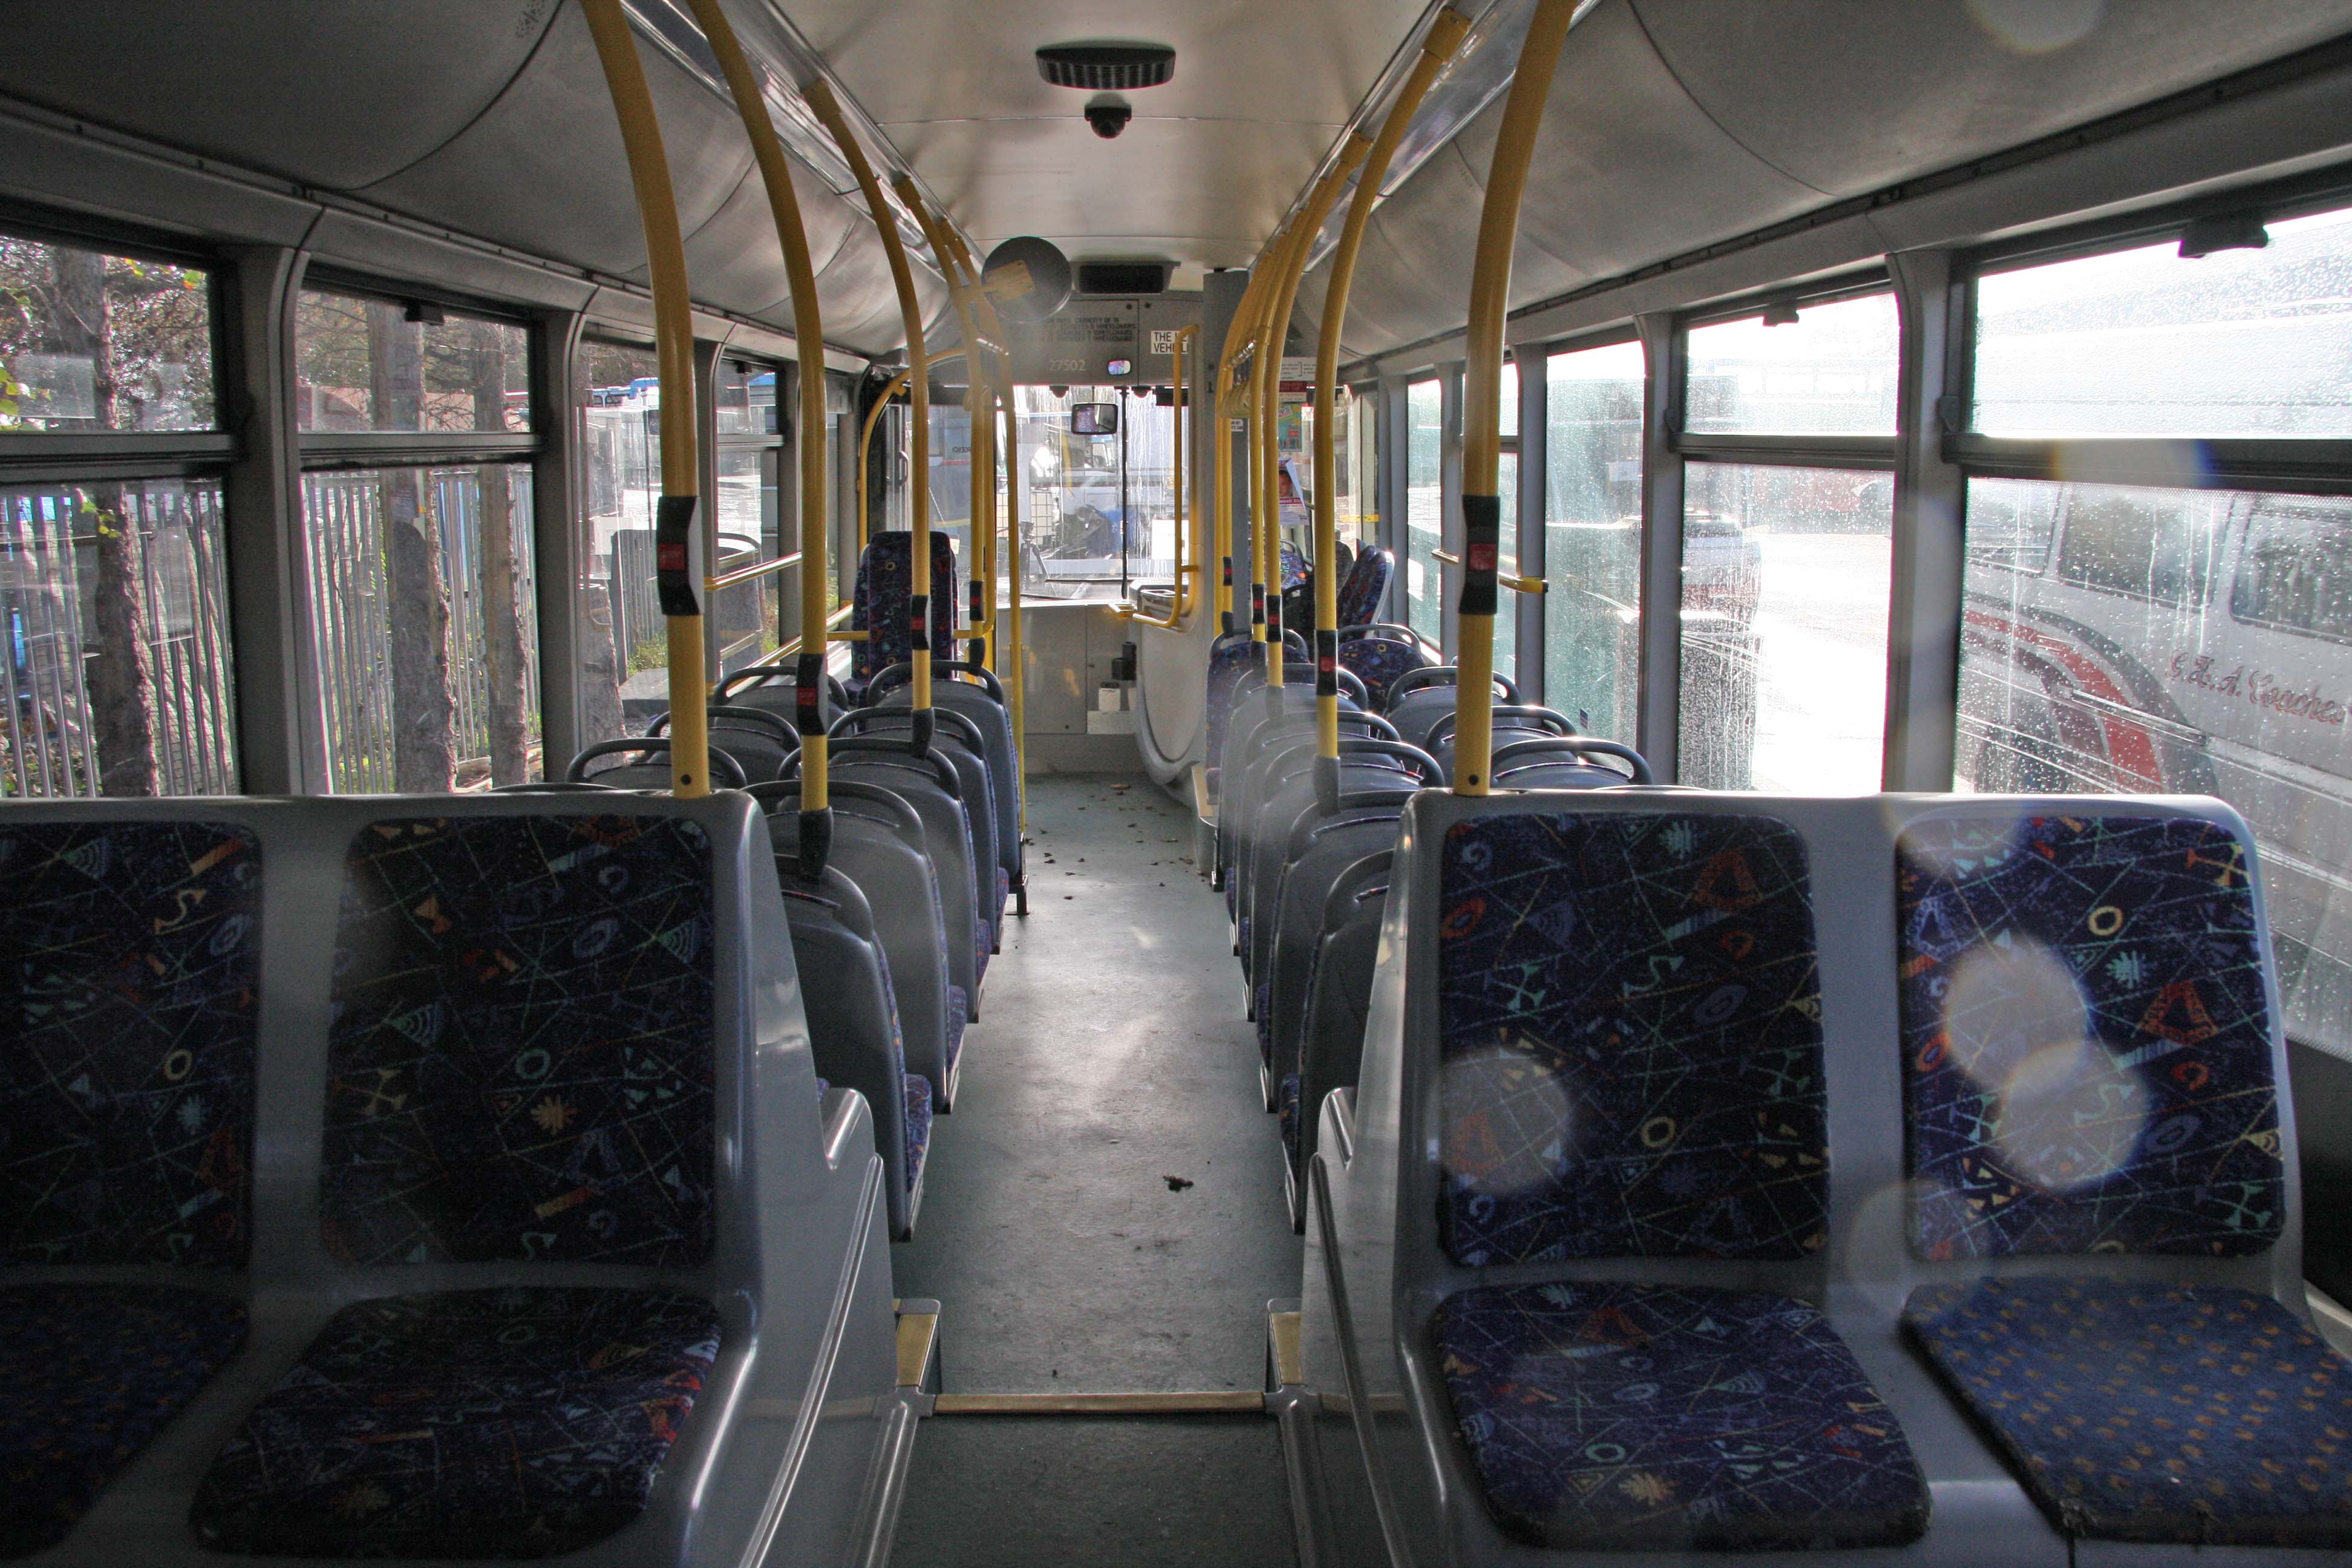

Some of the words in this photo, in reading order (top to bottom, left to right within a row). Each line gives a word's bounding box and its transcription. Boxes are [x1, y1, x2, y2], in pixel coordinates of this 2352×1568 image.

[1153, 332, 1172, 342] THE
[1154, 343, 1188, 353] VEHIL
[1049, 359, 1086, 371] 27502
